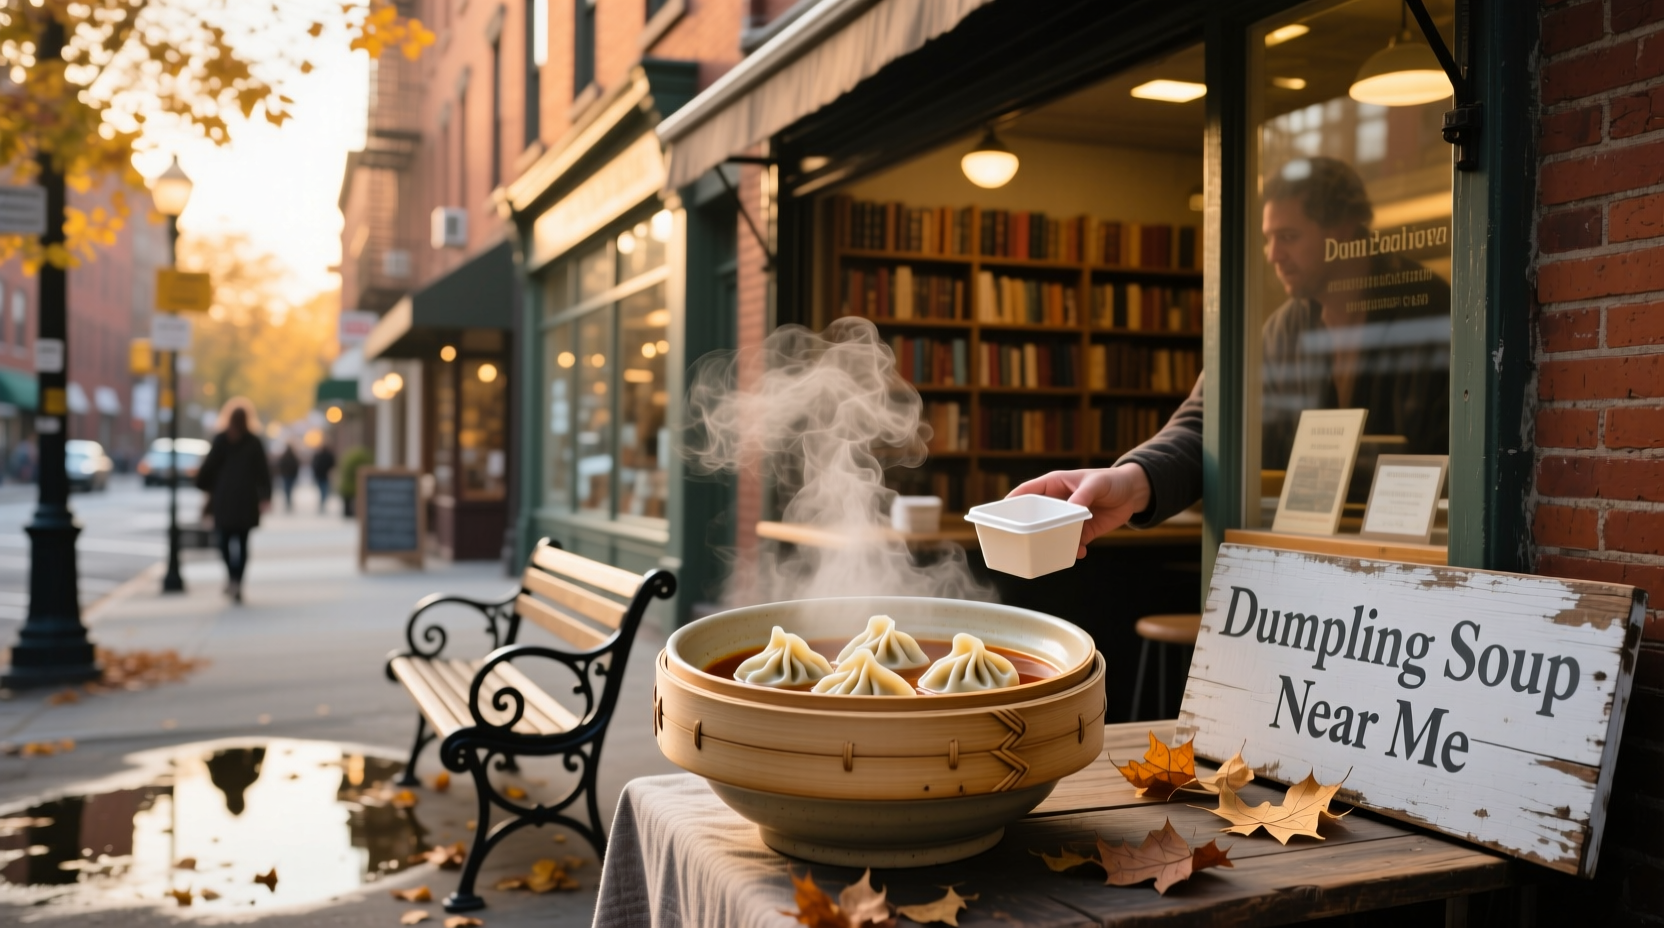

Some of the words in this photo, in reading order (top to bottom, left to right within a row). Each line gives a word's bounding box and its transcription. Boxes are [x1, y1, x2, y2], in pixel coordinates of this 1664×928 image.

[1218, 585, 1436, 690] Dumpling
[1443, 620, 1581, 718] Soup
[1268, 674, 1380, 751] Near
[1384, 699, 1470, 774] Me
